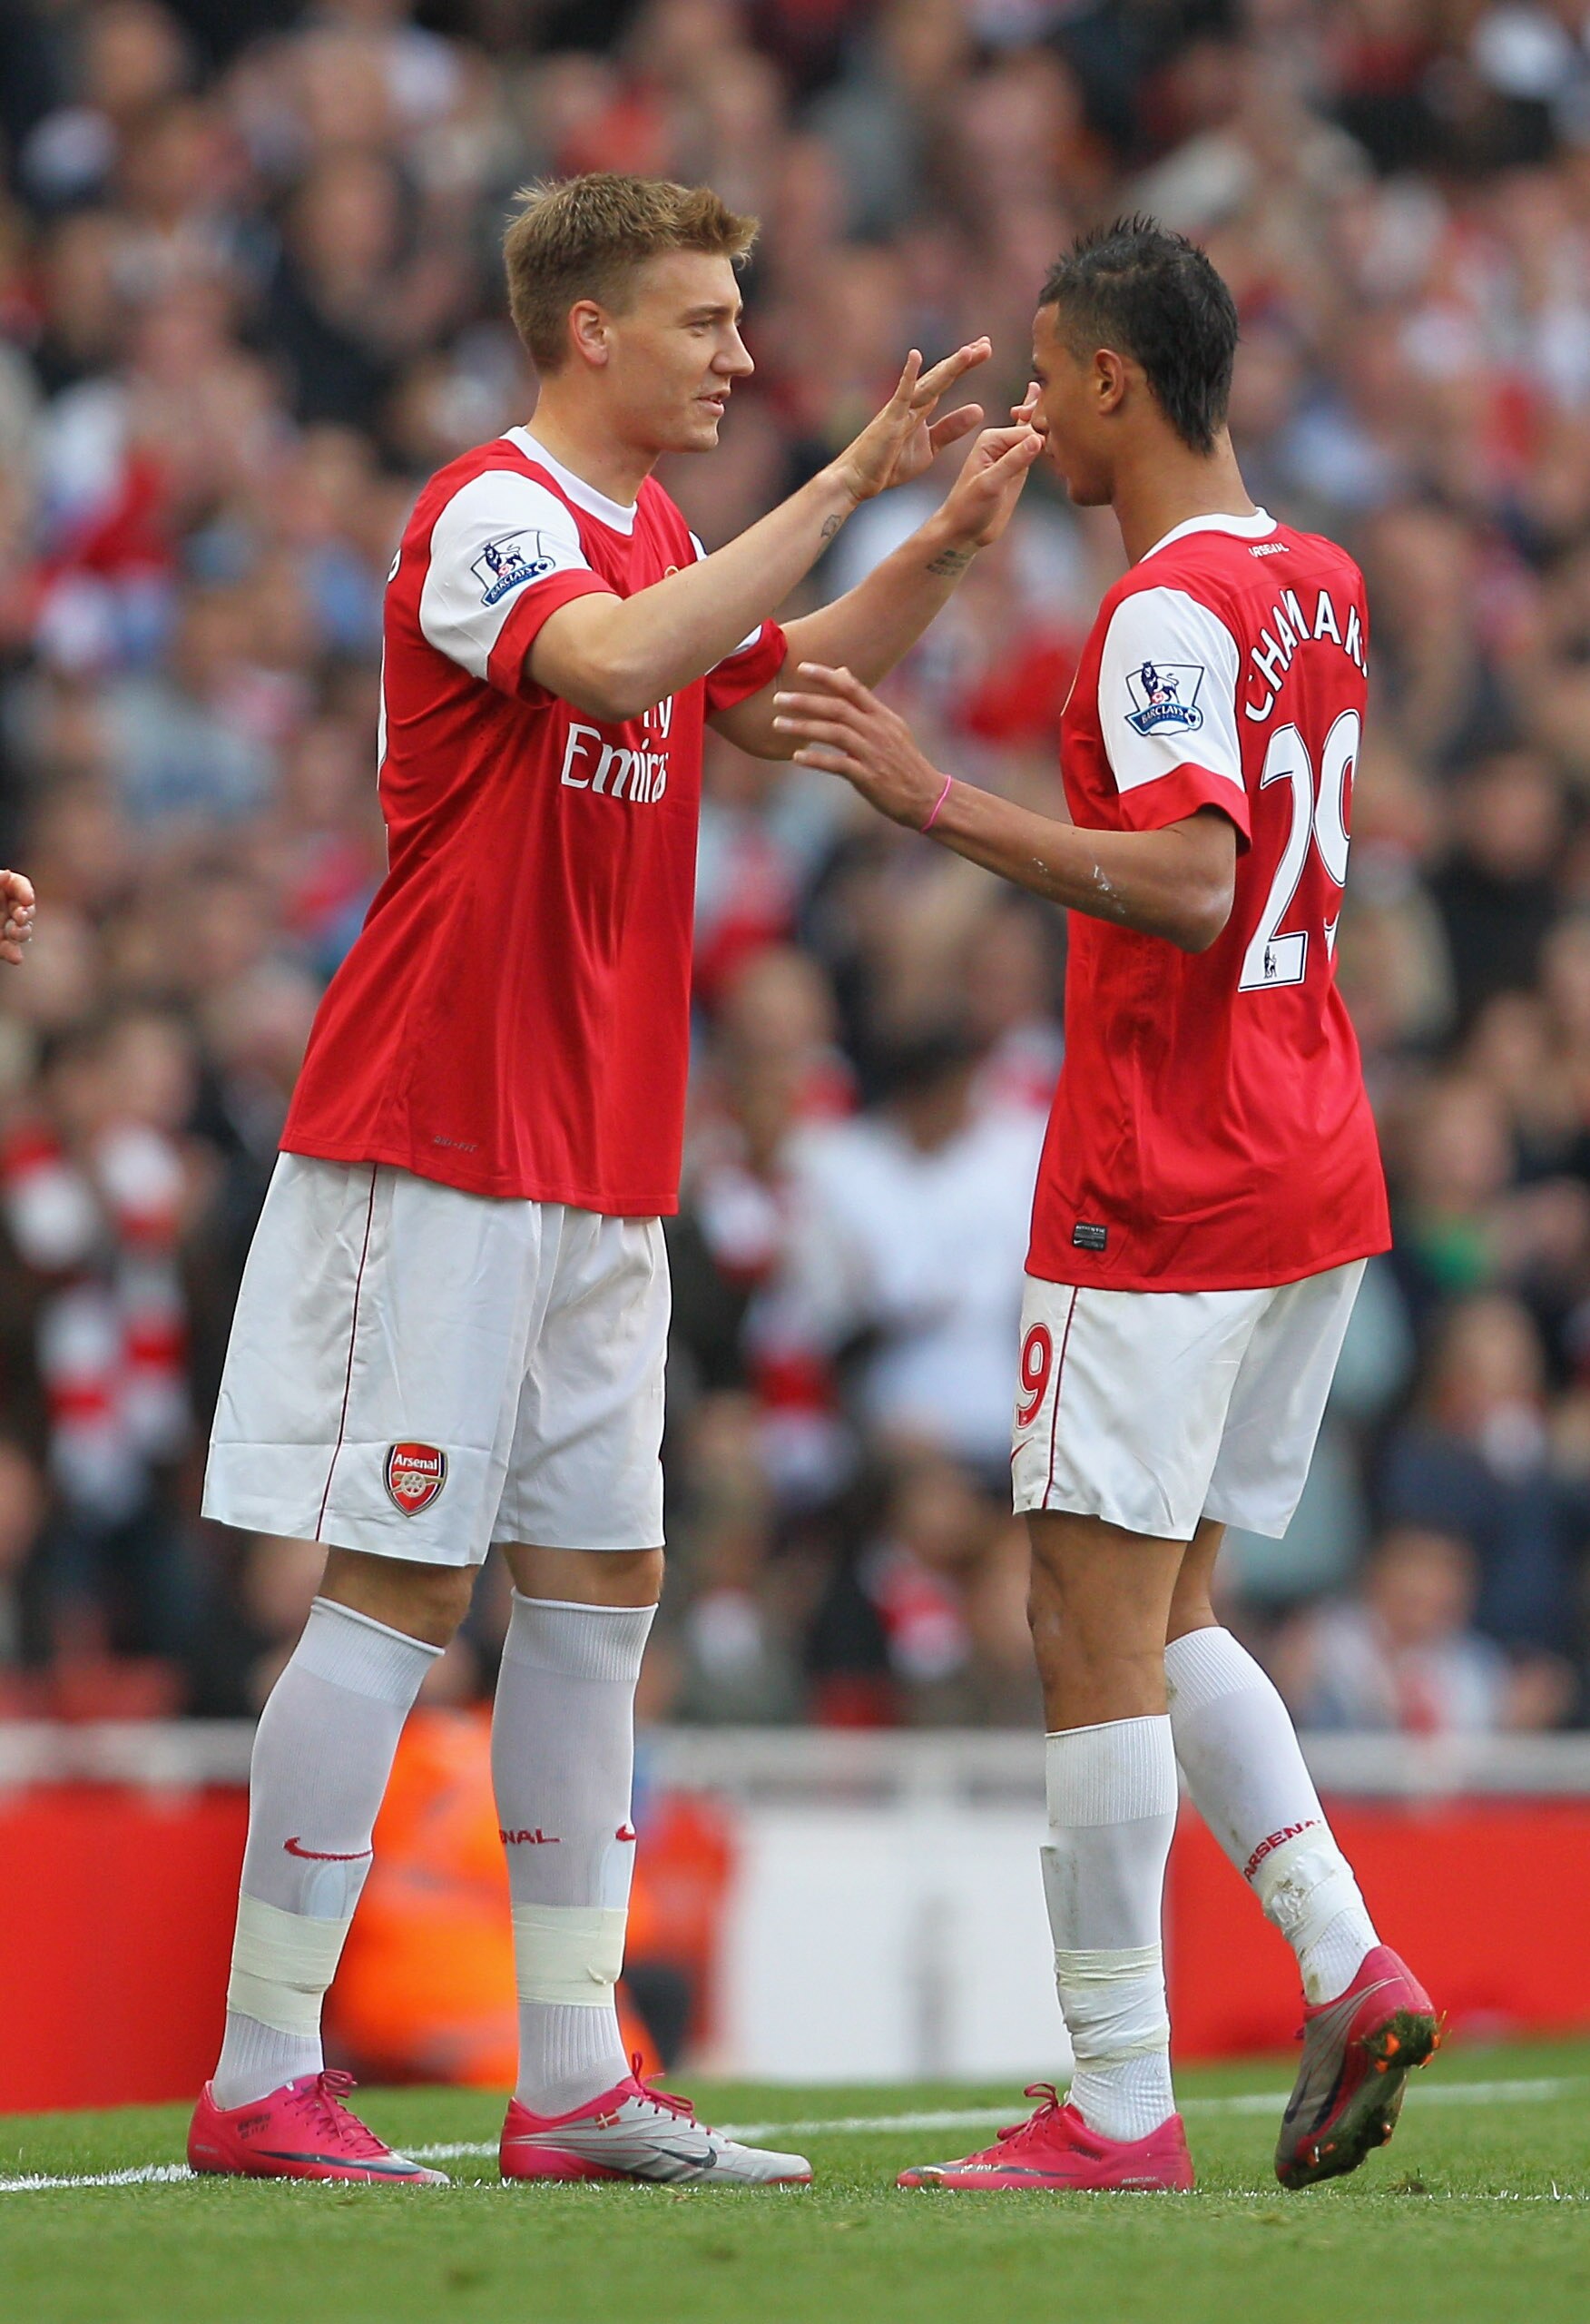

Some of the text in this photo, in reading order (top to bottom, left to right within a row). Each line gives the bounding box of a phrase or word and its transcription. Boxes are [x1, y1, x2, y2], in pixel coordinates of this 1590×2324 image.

[490, 566, 534, 599] BARCLAYS
[1245, 588, 1369, 722] CHAMAK
[1141, 705, 1184, 724] BARCLAYS
[561, 722, 670, 804] Emira
[1237, 708, 1361, 992] 29
[1016, 1322, 1054, 1429] 9
[394, 1453, 437, 1470] Arsenal
